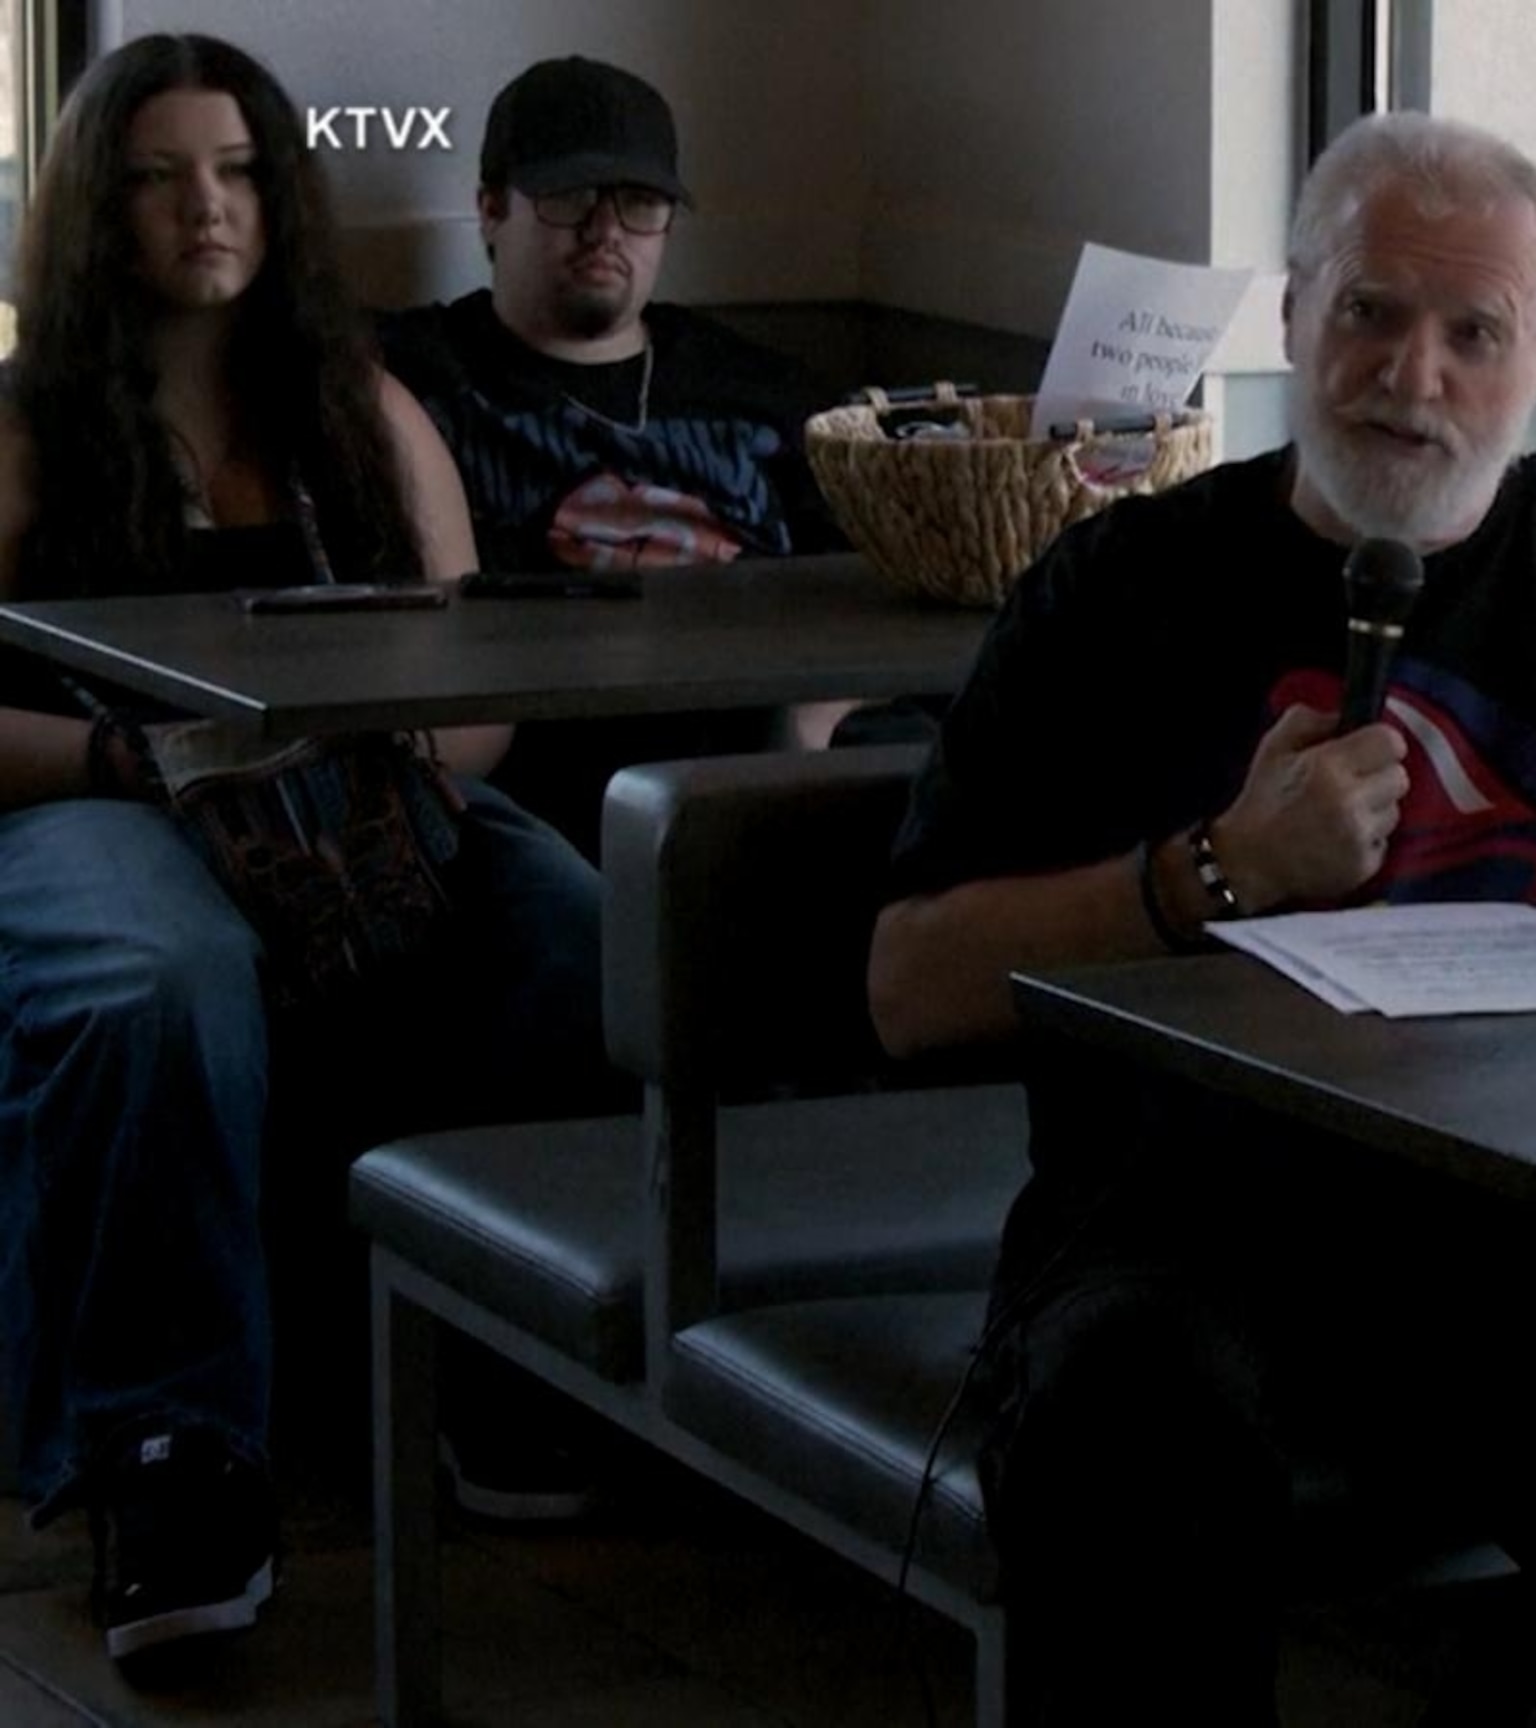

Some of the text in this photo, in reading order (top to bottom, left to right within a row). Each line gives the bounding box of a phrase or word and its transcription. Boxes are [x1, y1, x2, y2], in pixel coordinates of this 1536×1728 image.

[1116, 309, 1154, 335] All
[1090, 339, 1193, 379] two people
